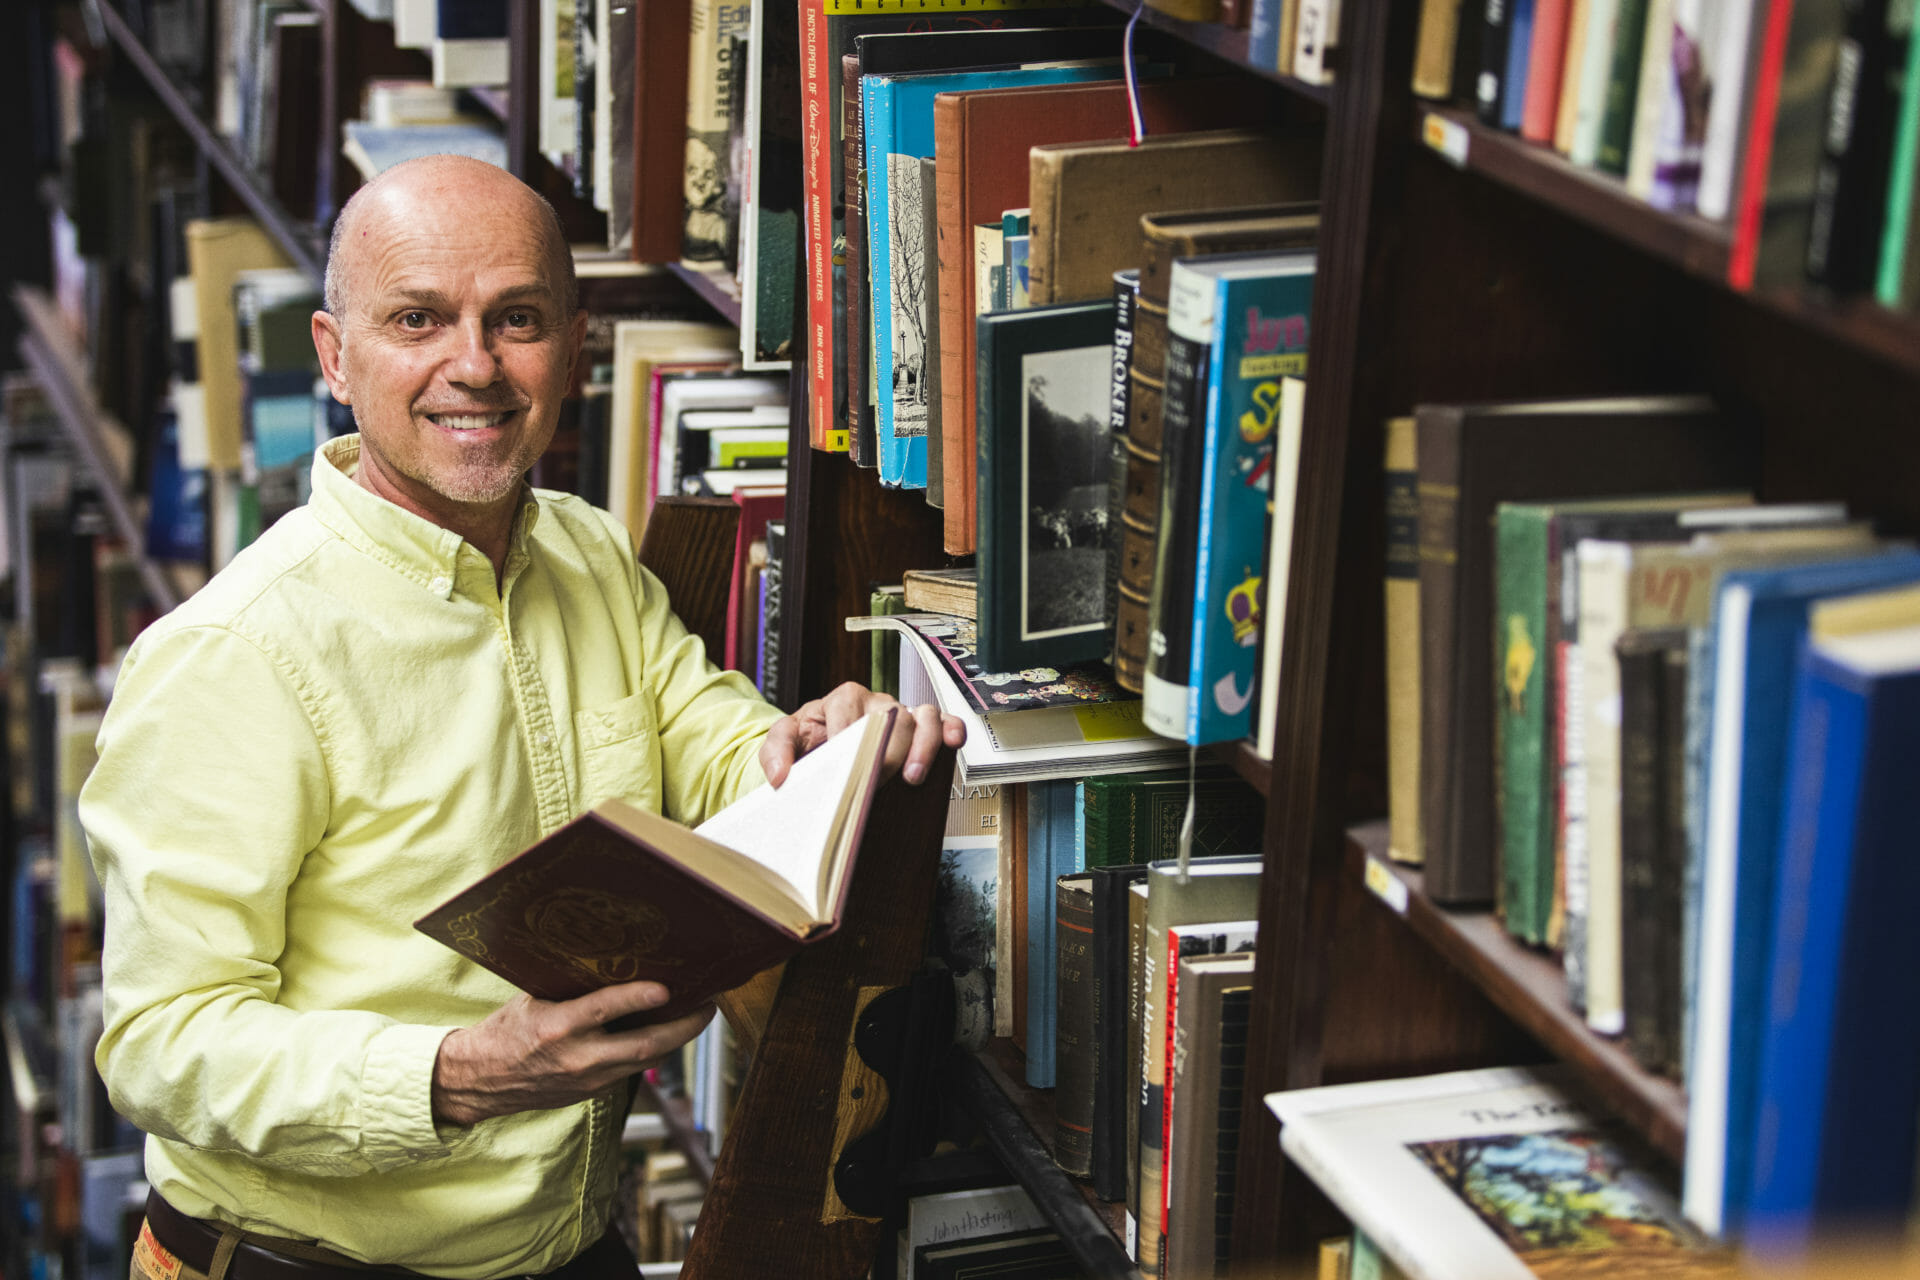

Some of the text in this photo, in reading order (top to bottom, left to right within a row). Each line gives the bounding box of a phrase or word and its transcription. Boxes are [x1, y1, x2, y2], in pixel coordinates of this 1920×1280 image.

[807, 8, 817, 79] ENCYCLOPEDIA
[808, 82, 817, 95] OF
[812, 194, 822, 240] ANIMATED
[814, 243, 824, 302] CHARACTERS
[816, 323, 825, 380] JOHN GRANT
[1111, 326, 1133, 429] BROKER
[1145, 947, 1156, 993] Jim
[1141, 1001, 1155, 1106] Harrison
